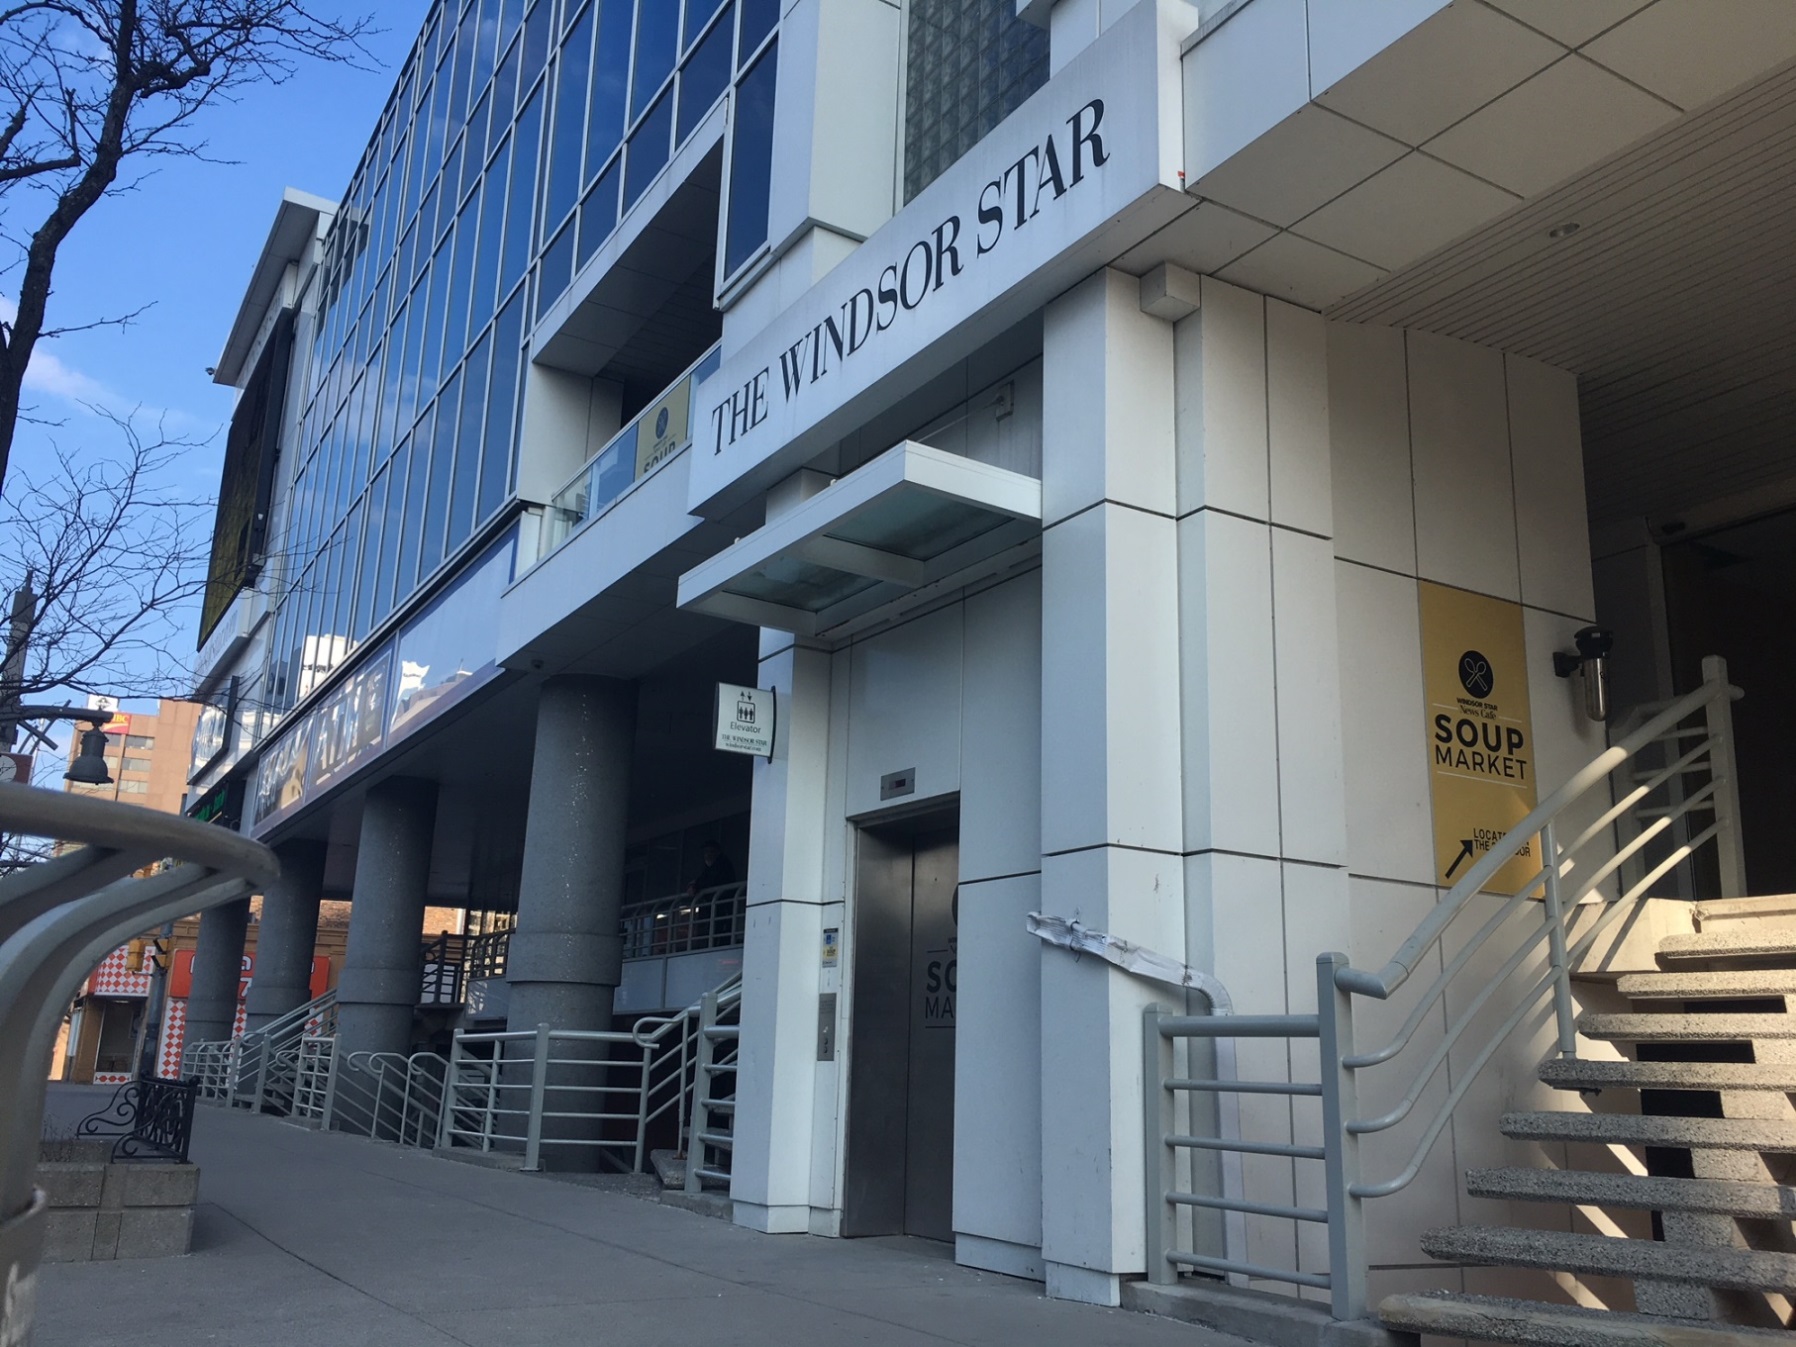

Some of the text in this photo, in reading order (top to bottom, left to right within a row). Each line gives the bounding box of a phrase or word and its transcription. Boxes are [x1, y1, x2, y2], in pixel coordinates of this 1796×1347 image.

[712, 98, 1111, 455] THE WINDSOR STAR
[1460, 705, 1480, 717] News
[1484, 702, 1498, 711] STAR
[730, 721, 762, 734] Elevator
[1434, 713, 1524, 756] SOUP
[1435, 744, 1528, 780] MARKET
[1473, 827, 1507, 842] LOCAT
[1474, 838, 1490, 852] THE
[926, 960, 957, 994] SO
